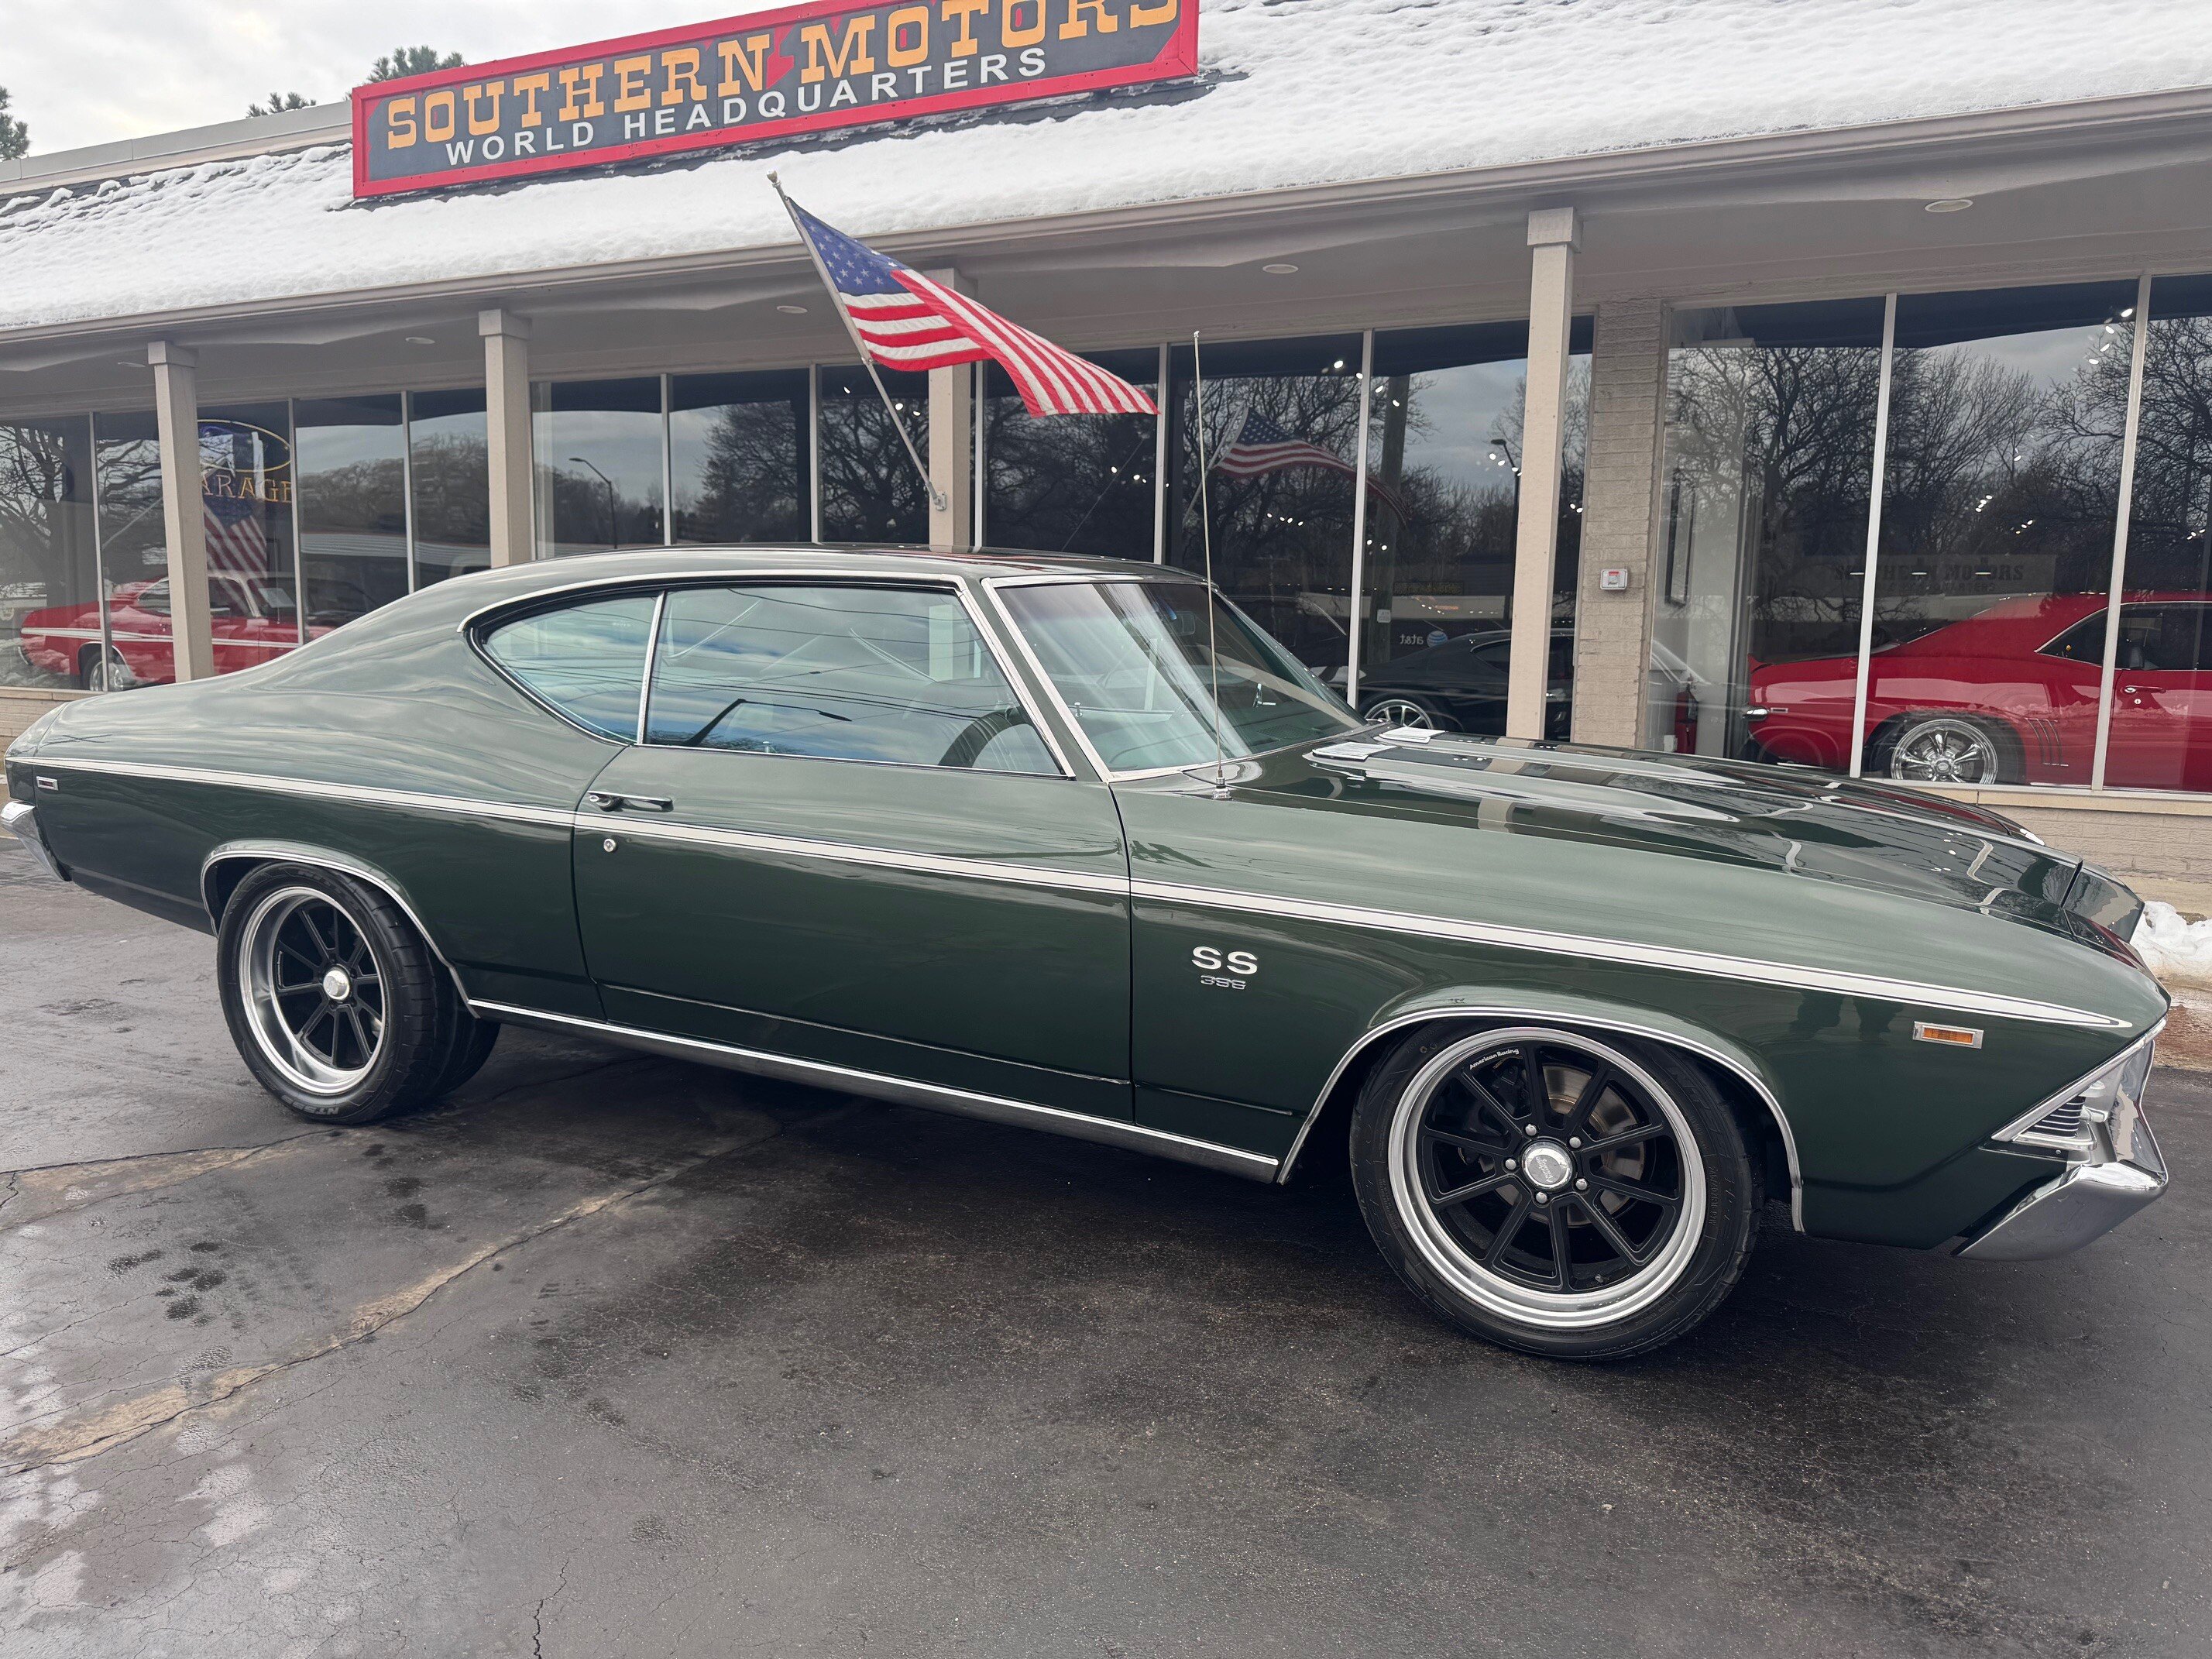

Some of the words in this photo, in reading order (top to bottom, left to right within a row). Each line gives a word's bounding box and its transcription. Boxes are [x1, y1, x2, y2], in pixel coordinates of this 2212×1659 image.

[388, 34, 770, 149] SOUTHERN
[445, 122, 594, 166] WORLD
[624, 47, 1046, 139] HEADQUARTERS
[201, 474, 292, 503] ARAGE
[1191, 946, 1259, 974] SS
[1470, 1053, 1498, 1070] American
